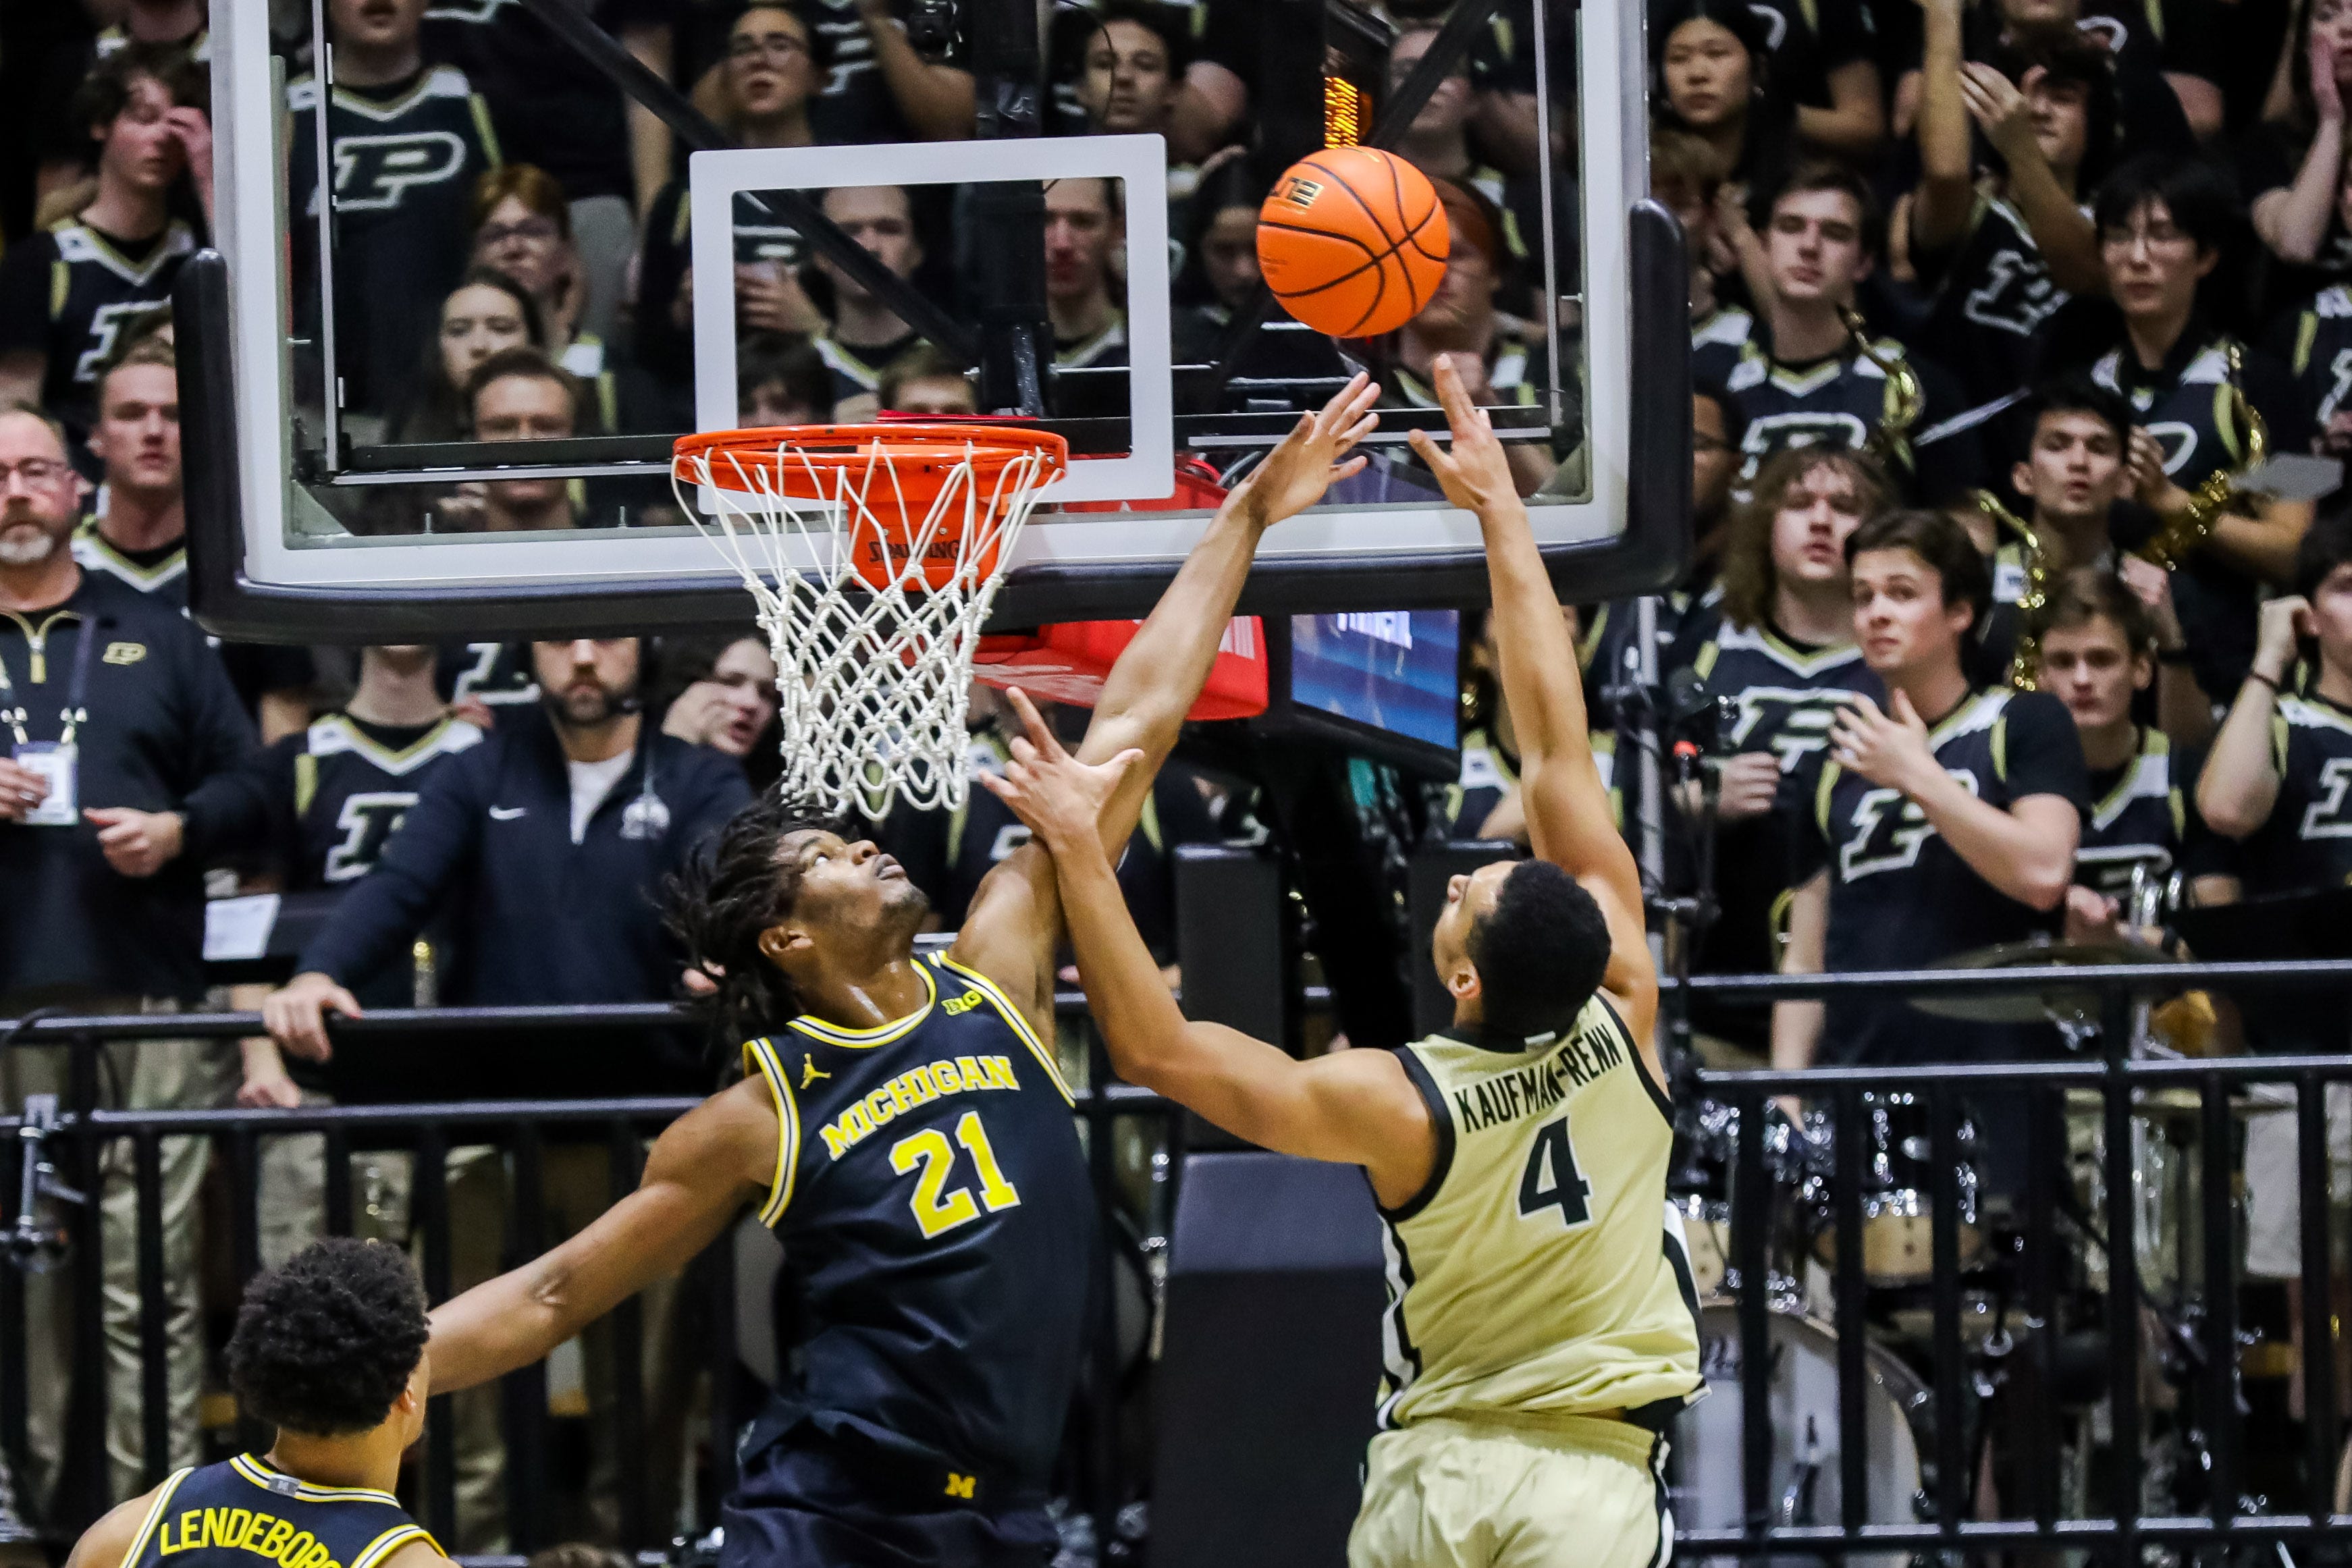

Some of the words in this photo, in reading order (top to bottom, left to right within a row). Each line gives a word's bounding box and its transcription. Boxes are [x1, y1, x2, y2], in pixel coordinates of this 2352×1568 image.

[818, 1055, 1021, 1162] MICHIGAN
[1453, 1023, 1623, 1134] KAUFMAN-RENN
[888, 1110, 1022, 1240] 21
[1518, 1114, 1594, 1230] 4
[160, 1507, 342, 1568] LENDEBOR
[944, 1472, 977, 1499] M
